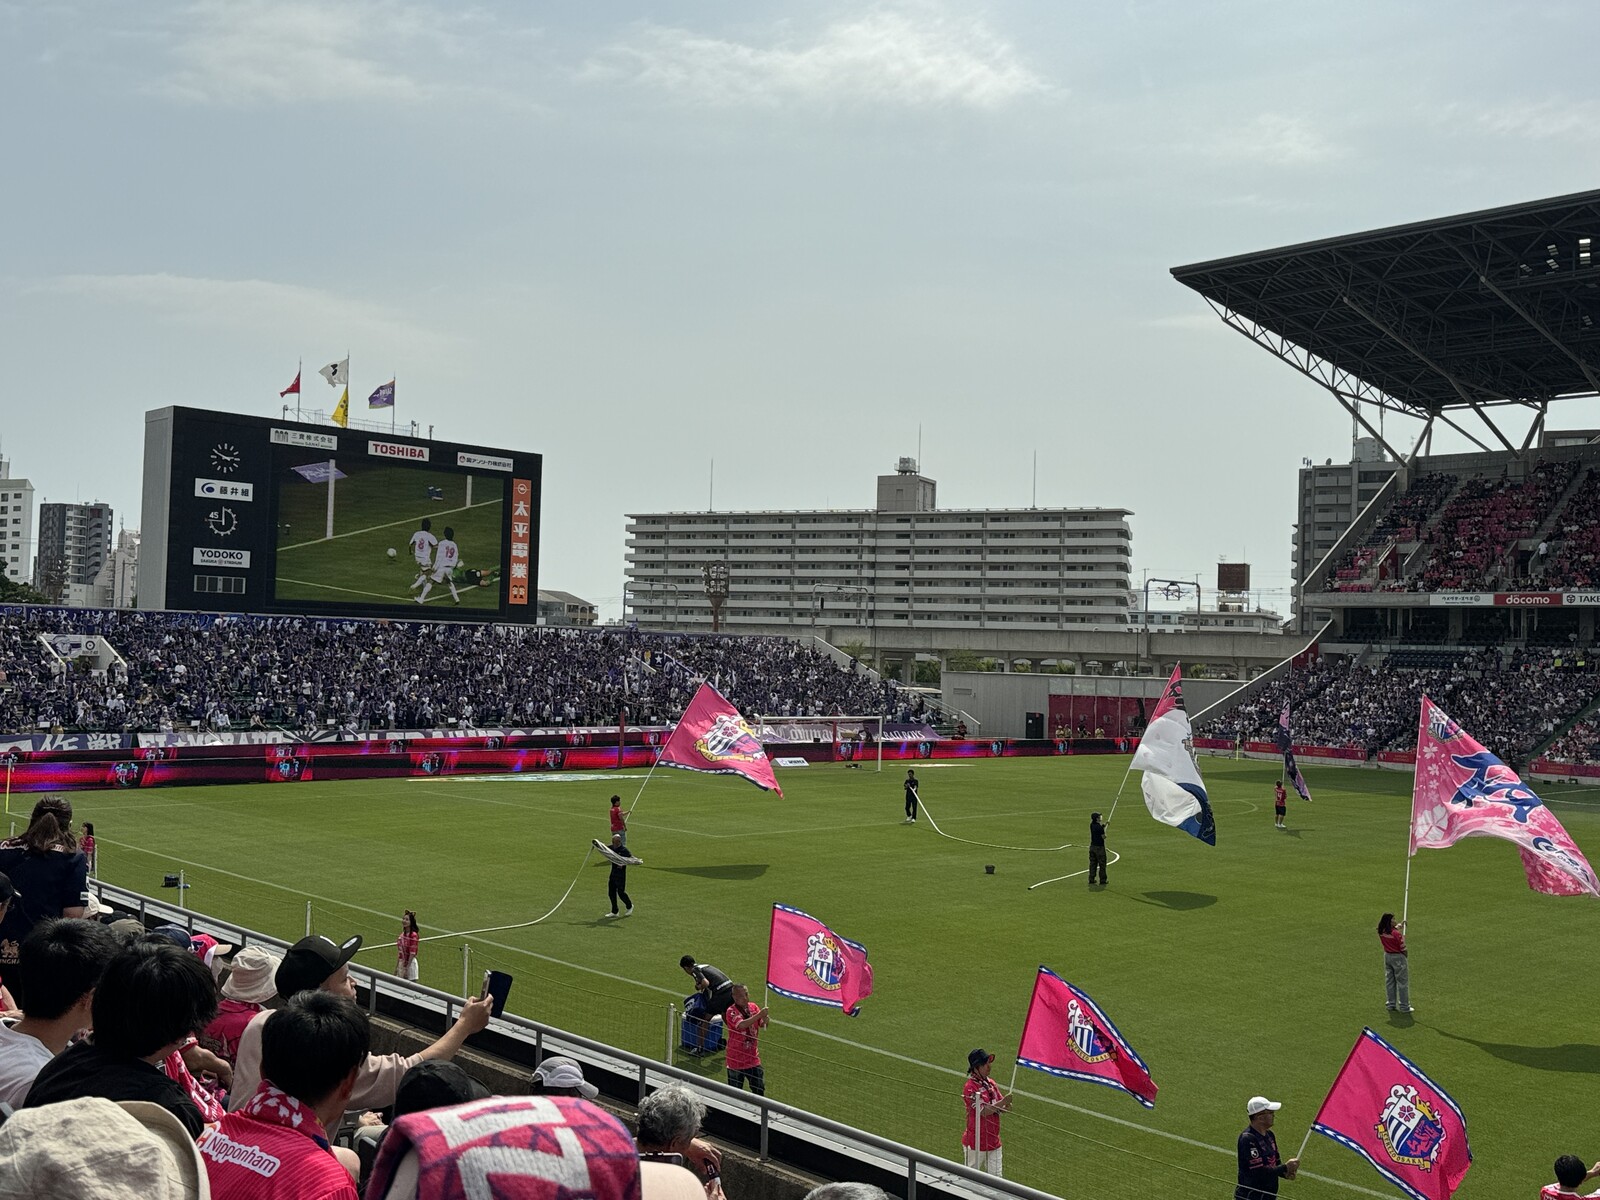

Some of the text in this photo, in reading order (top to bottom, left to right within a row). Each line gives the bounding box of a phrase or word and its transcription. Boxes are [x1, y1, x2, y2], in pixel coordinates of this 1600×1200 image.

[372, 443, 425, 459] TOSHIBA
[220, 486, 250, 497] 藤井組
[209, 511, 219, 519] 45
[511, 500, 529, 579] 太平電業
[200, 549, 243, 560] YODOKO
[445, 545, 455, 559] 19
[1505, 594, 1550, 605] docomo
[206, 1135, 277, 1174] Nipponham
[1383, 1132, 1421, 1165] CEREZO OSAKA
